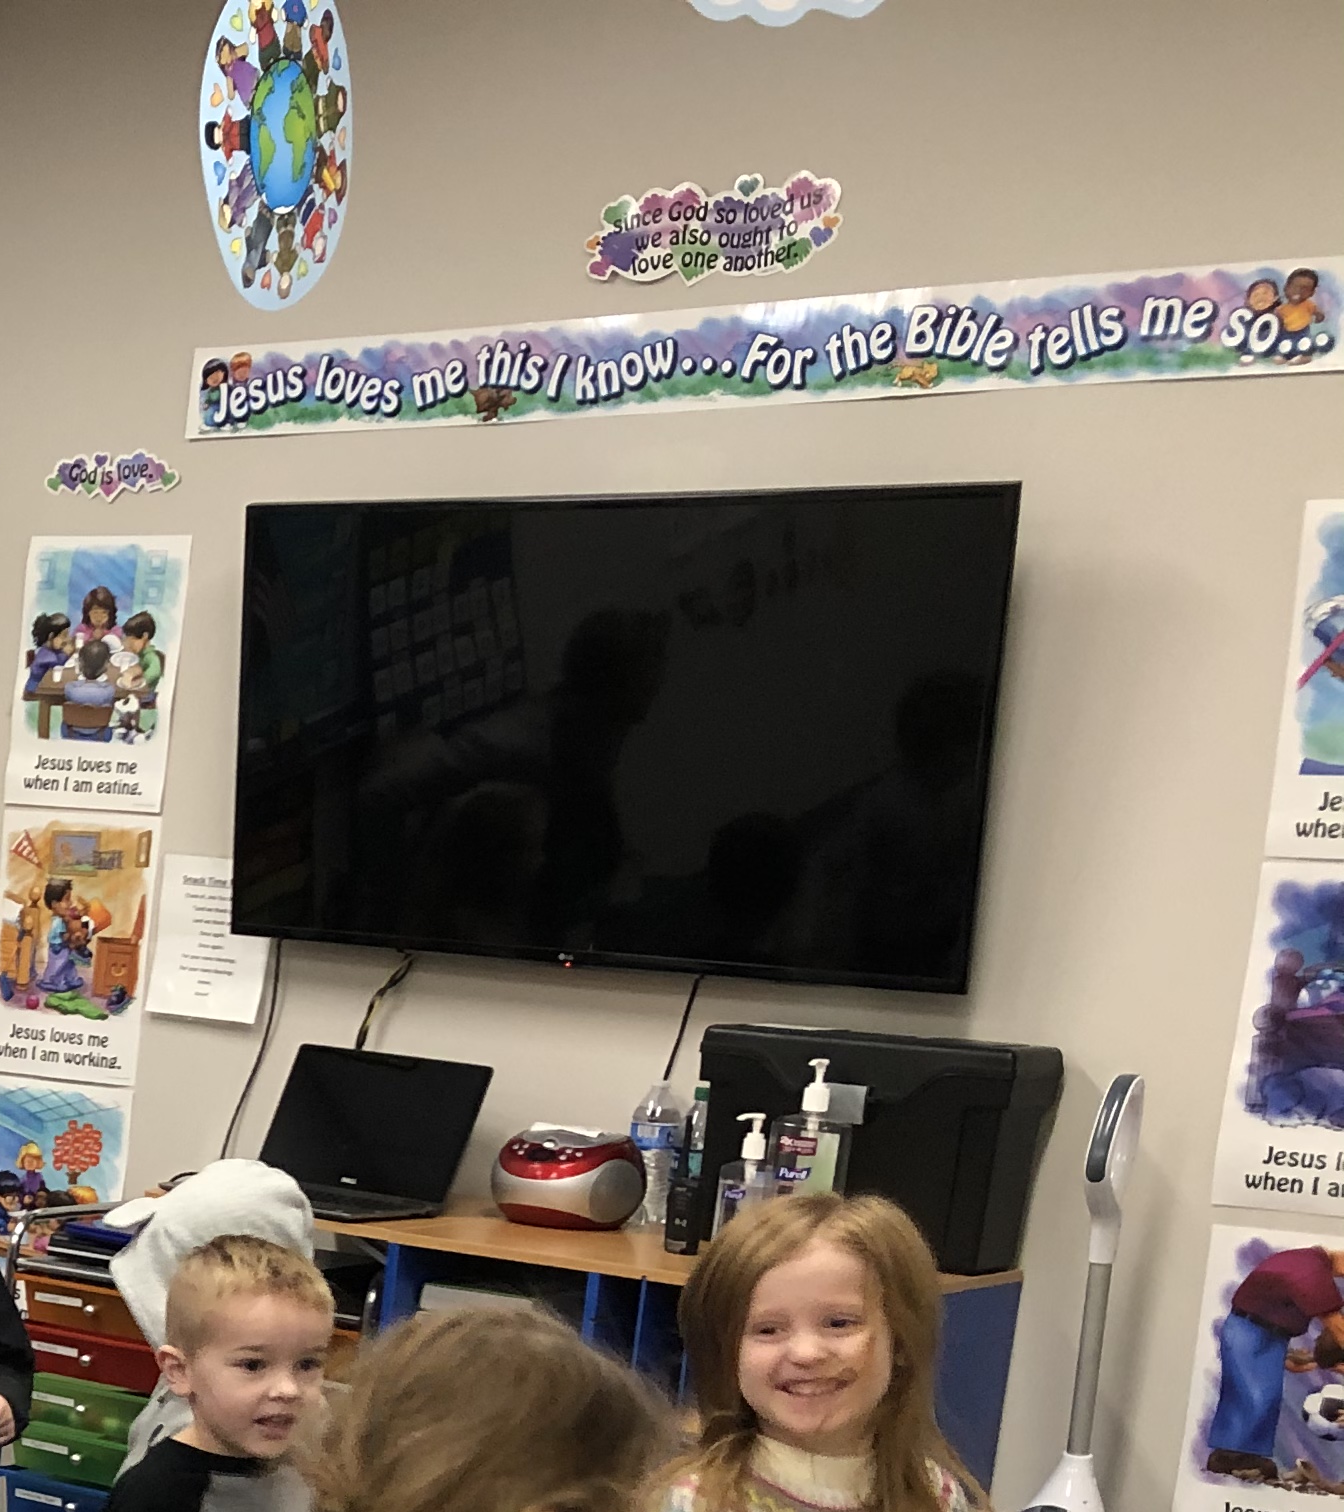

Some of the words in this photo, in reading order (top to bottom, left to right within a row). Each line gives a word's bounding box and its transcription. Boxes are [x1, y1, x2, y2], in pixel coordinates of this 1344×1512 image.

[613, 207, 662, 235] since
[669, 200, 709, 222] God
[715, 208, 737, 225] so
[743, 197, 794, 225] loved
[800, 187, 824, 210] us
[635, 232, 662, 251] we
[670, 225, 711, 246] also
[719, 229, 772, 249] ought
[778, 220, 798, 241] to
[631, 253, 673, 276] love
[682, 251, 717, 270] one
[724, 243, 798, 272] another.
[214, 363, 305, 427] Jesus
[315, 354, 403, 416] loves
[412, 356, 467, 411] me
[476, 339, 543, 391] this
[547, 352, 568, 401] I
[826, 322, 898, 380] the
[905, 304, 1015, 372] Bible
[1028, 303, 1125, 374] tells
[1140, 295, 1216, 342] me
[1222, 307, 1334, 357] so...
[69, 462, 98, 486] God
[101, 467, 113, 485] is
[116, 462, 153, 481] love.
[34, 754, 73, 772] Jesus
[76, 755, 112, 774] loves
[116, 760, 138, 775] me
[23, 776, 60, 792] when
[63, 777, 70, 792] I
[73, 779, 93, 793] am
[96, 778, 143, 797] eating.
[9, 1023, 46, 1042] Jesus
[49, 1026, 85, 1046] loves
[88, 1032, 109, 1049] me
[30, 1044, 37, 1060] I
[40, 1049, 60, 1064] am
[63, 1049, 122, 1071] working.
[779, 1167, 808, 1180] Purell
